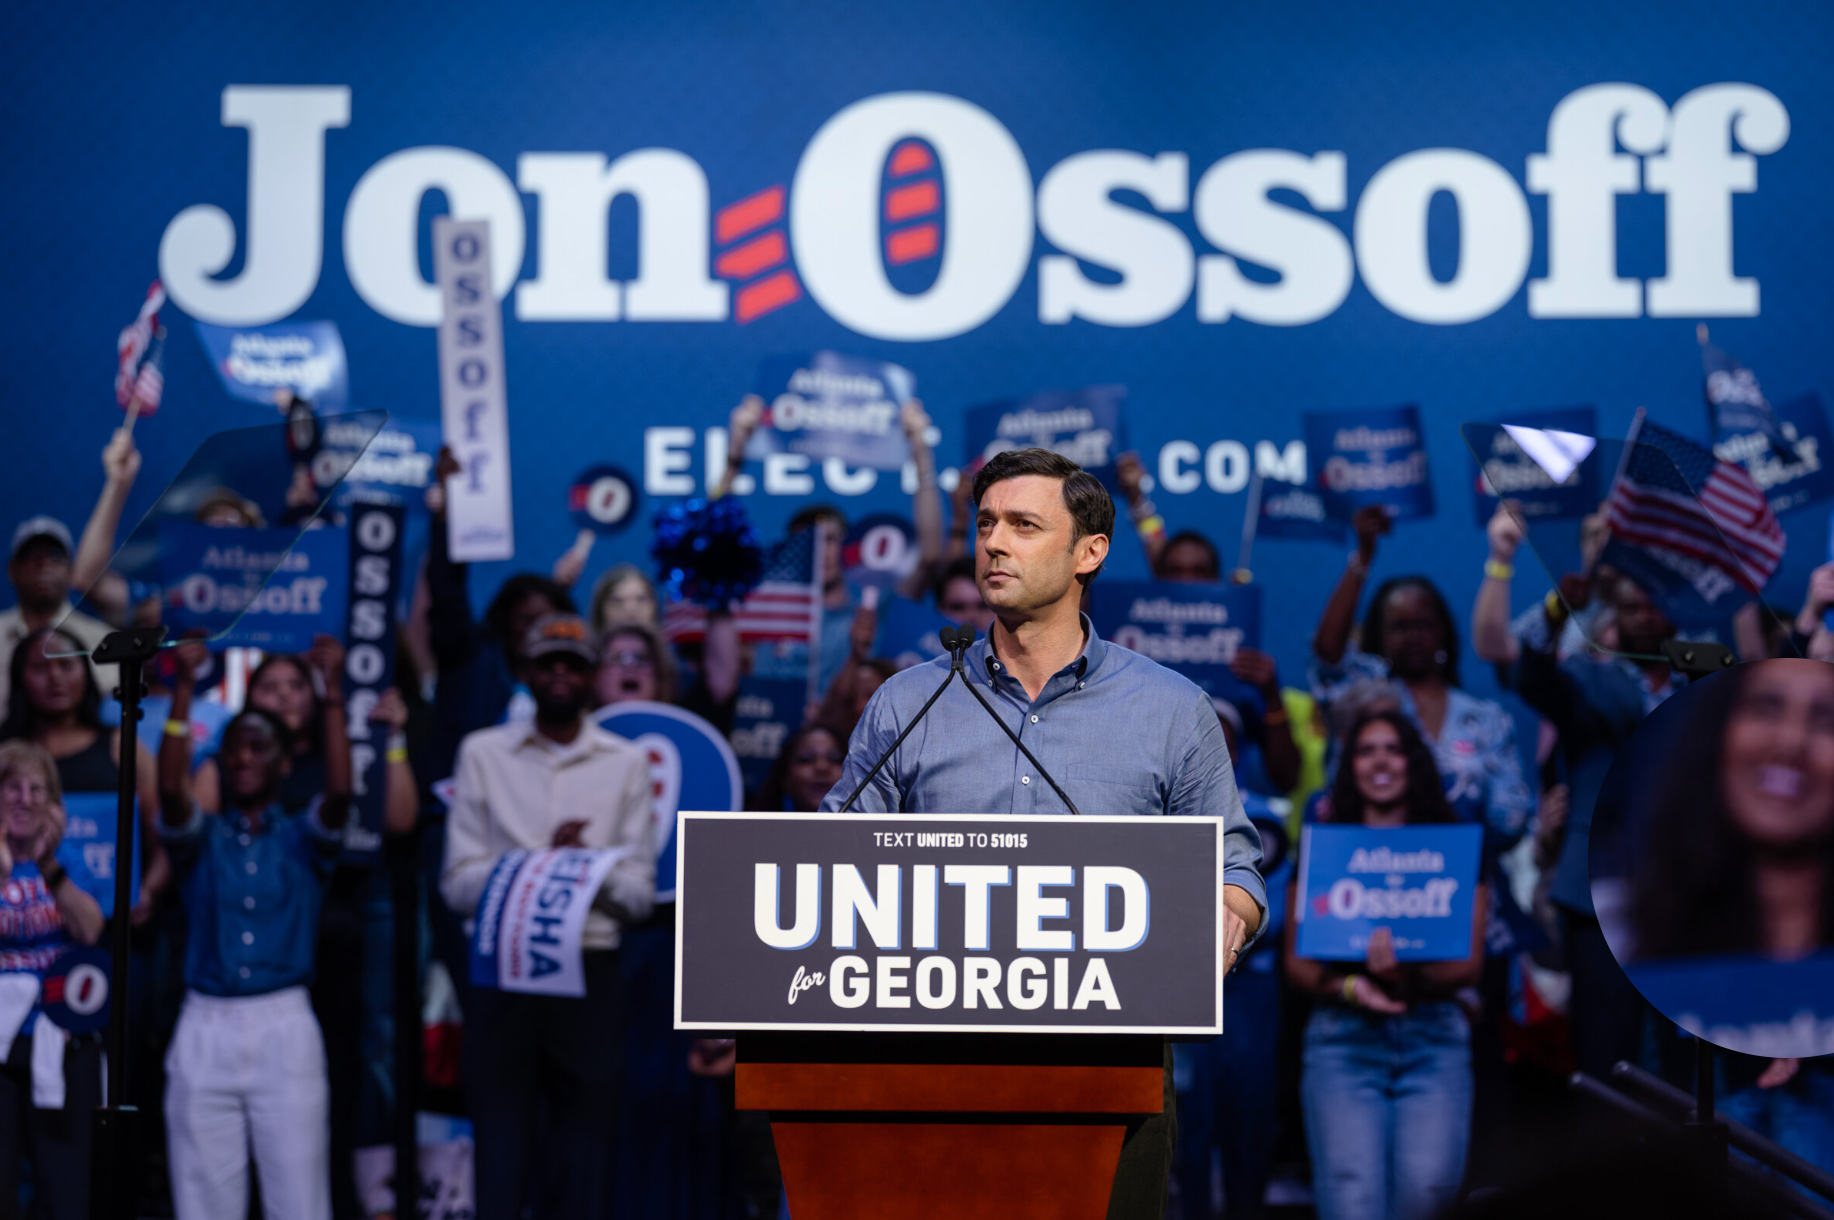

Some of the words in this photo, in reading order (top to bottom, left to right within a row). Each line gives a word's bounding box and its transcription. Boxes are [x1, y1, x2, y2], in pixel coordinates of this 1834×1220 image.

[158, 83, 730, 328] Jon
[789, 81, 1790, 343] Ossoff
[181, 573, 328, 614] Ossoff
[874, 832, 914, 848] TEXT
[917, 832, 964, 848] UNITED
[967, 833, 988, 848] TO
[990, 833, 1028, 848] 51015
[754, 862, 1151, 952] UNITED
[1328, 877, 1459, 921] Ossoff
[788, 965, 827, 1006] for
[829, 954, 1122, 1011] GEORGIA
